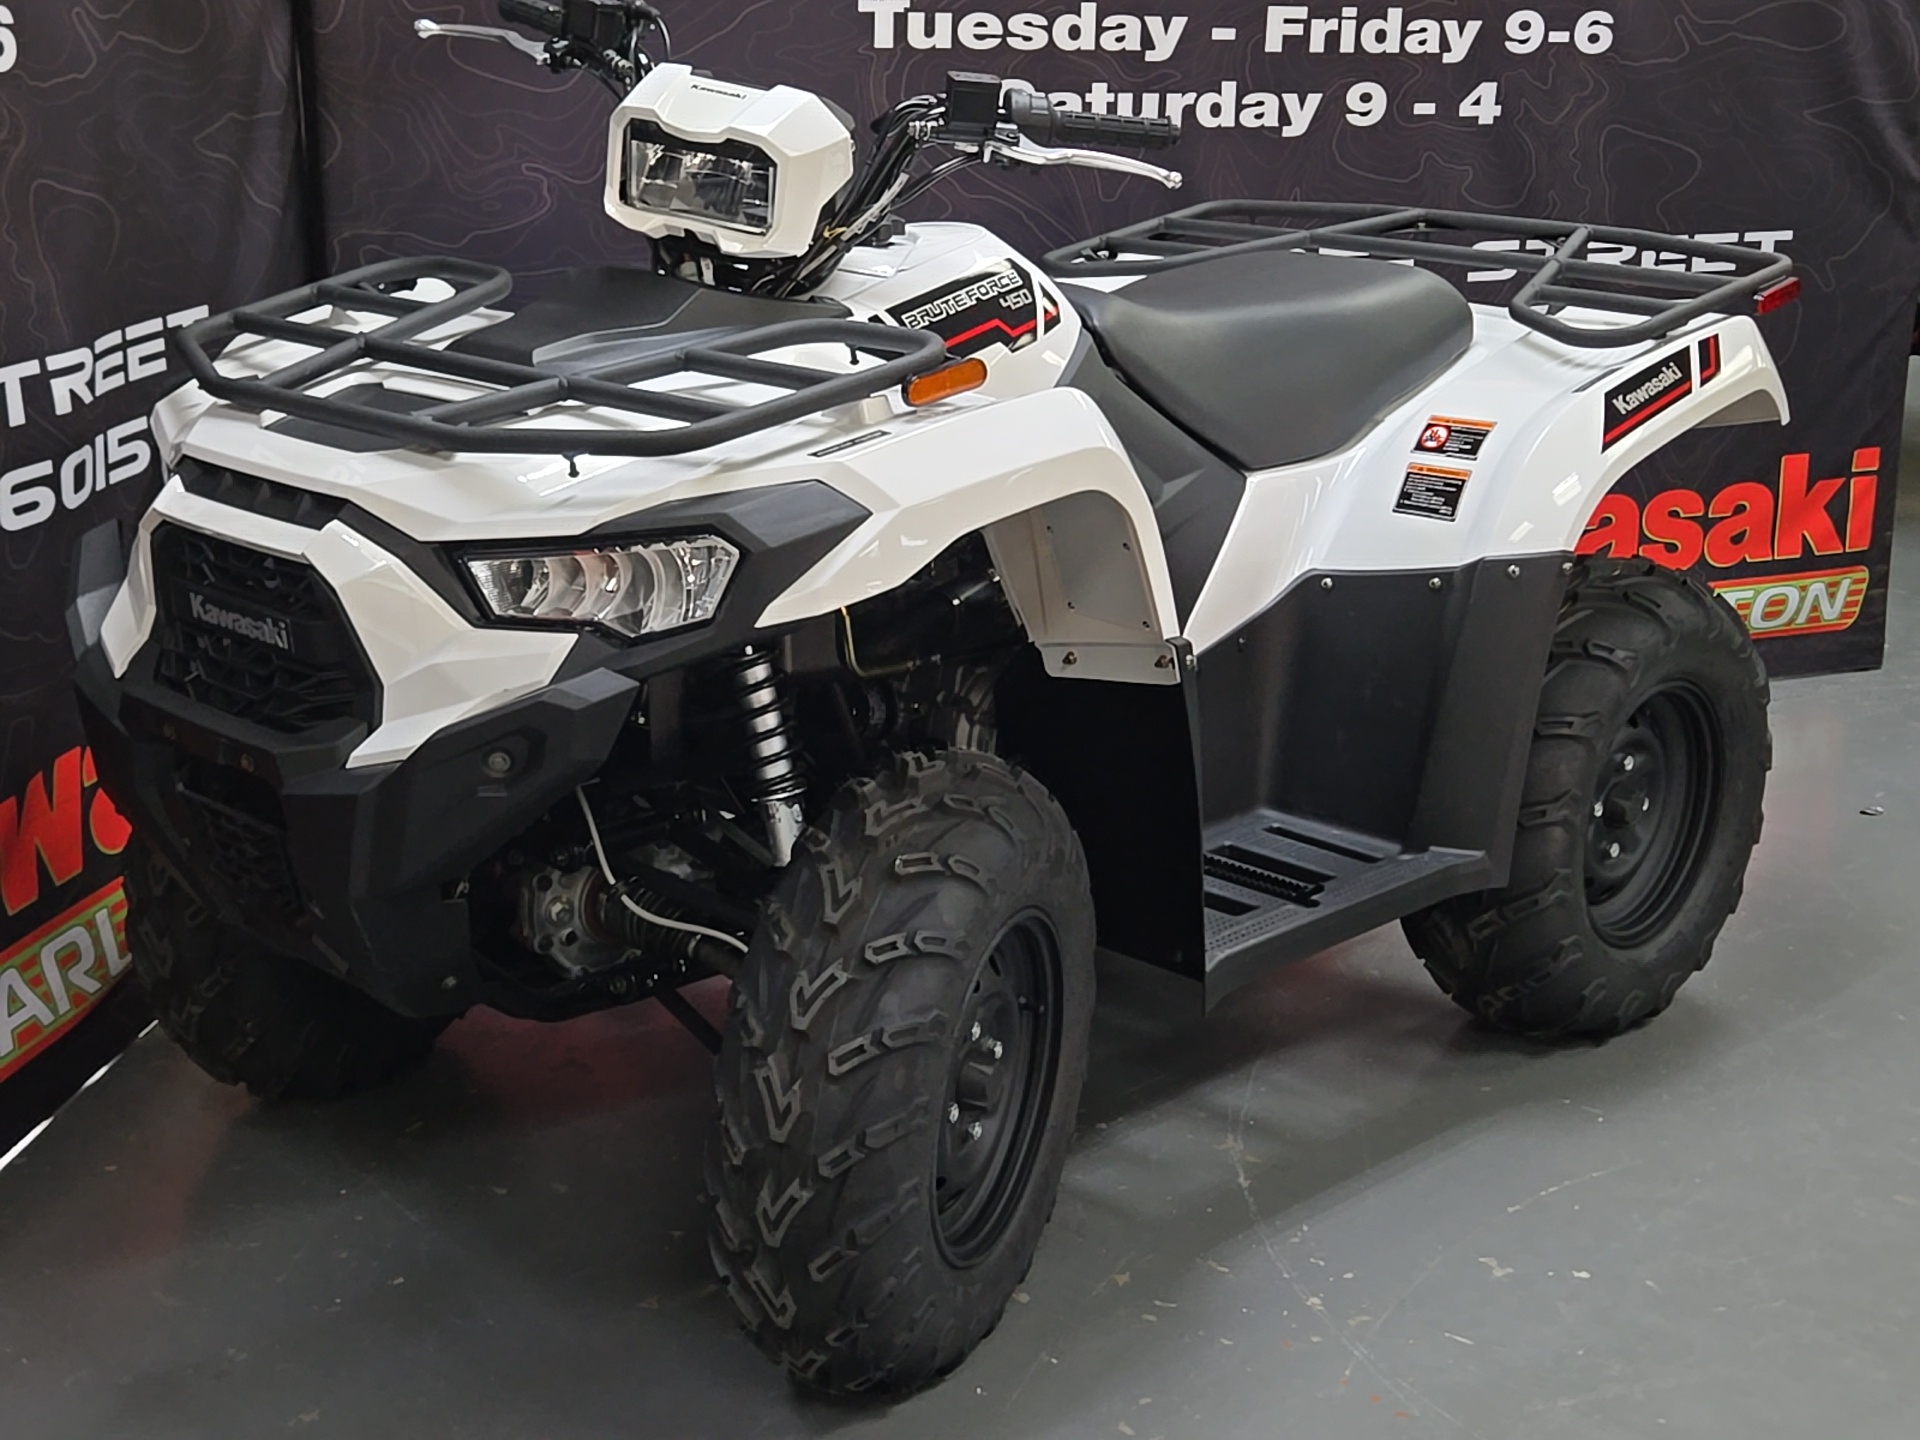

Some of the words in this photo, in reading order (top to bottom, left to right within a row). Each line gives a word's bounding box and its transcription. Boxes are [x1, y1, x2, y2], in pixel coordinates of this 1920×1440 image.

[857, 0, 1189, 62] Tuesday
[1264, 5, 1483, 64] Friday
[1504, 9, 1615, 55] 9-6
[1345, 82, 1389, 127] 9
[1458, 82, 1502, 126] 4
[999, 288, 1033, 310] 450
[1611, 361, 1683, 416] Kawasaki
[189, 591, 289, 651] Kawasaki
